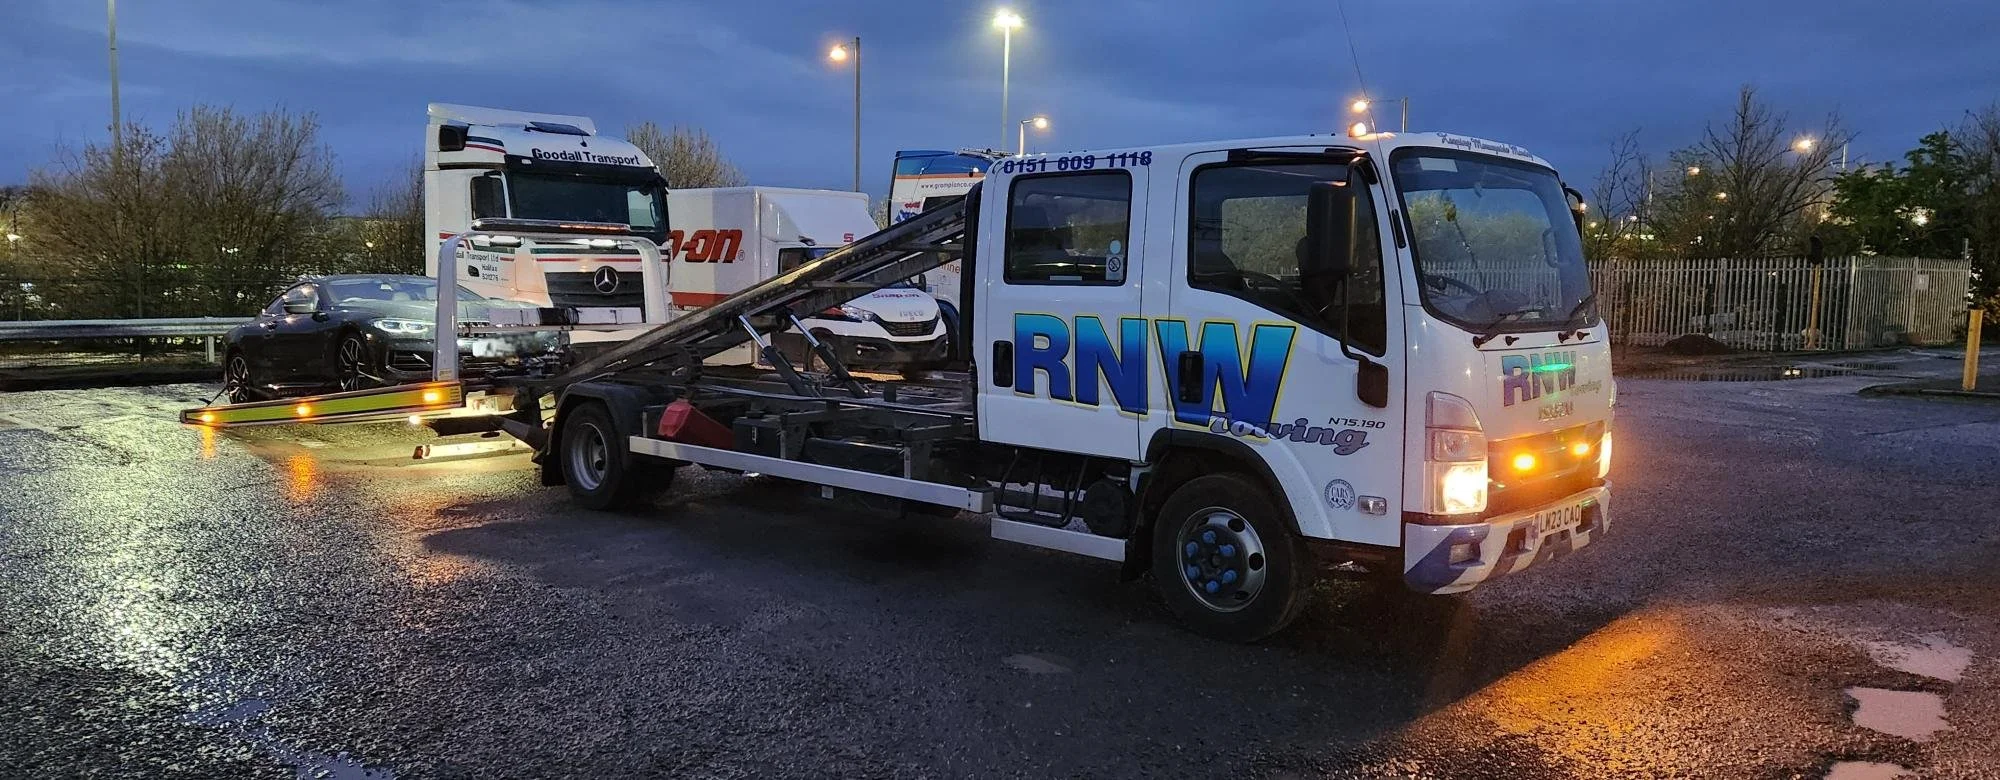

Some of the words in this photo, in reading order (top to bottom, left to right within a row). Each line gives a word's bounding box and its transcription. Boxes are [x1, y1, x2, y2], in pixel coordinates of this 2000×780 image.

[531, 148, 582, 160] Goodall
[583, 151, 640, 165] Transport
[1003, 158, 1047, 174] 0151
[1057, 155, 1095, 171] 609
[1107, 151, 1153, 168] 1118
[1013, 311, 1298, 443] RNW
[1502, 351, 1577, 407] RNW
[1209, 411, 1370, 456] towing
[1328, 417, 1386, 429] N75.190
